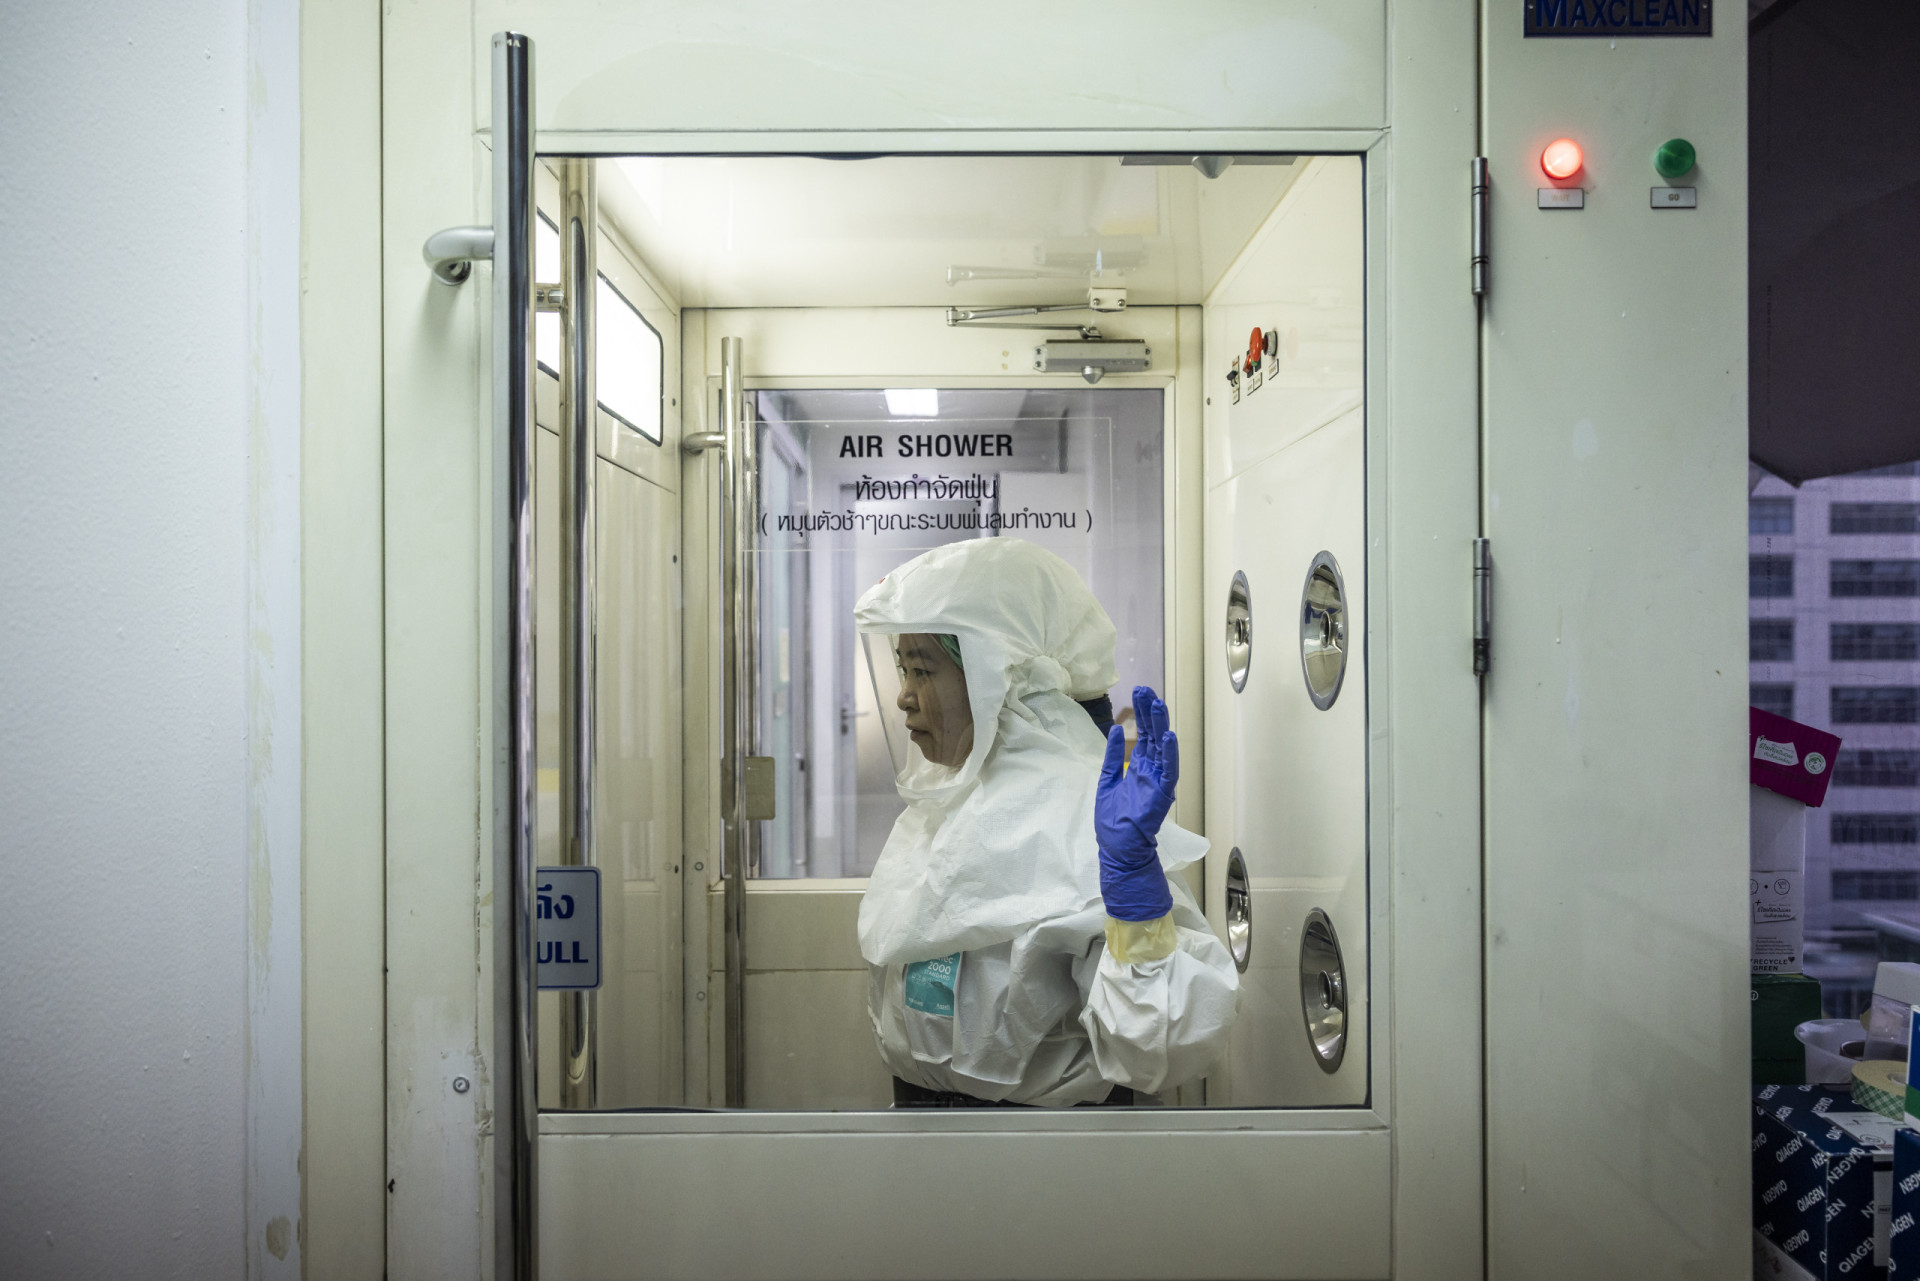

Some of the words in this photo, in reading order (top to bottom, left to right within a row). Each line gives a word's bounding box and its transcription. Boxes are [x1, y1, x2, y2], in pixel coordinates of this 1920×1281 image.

[1535, 0, 1700, 27] MAXCLEAN
[1668, 193, 1680, 202] GO
[839, 435, 883, 458] AIR
[898, 433, 1013, 458] SHOWER
[855, 473, 997, 507] ห้องกำจัดฝุ่น
[537, 941, 589, 964] ULL
[927, 961, 951, 975] 2000
[1775, 1135, 1804, 1163] QIAGEN
[1827, 1146, 1866, 1185] QIAGEN
[1761, 1179, 1788, 1206] QIAGEN
[1796, 1185, 1826, 1213] QIAGEN
[1782, 1229, 1810, 1254] QIAGEN
